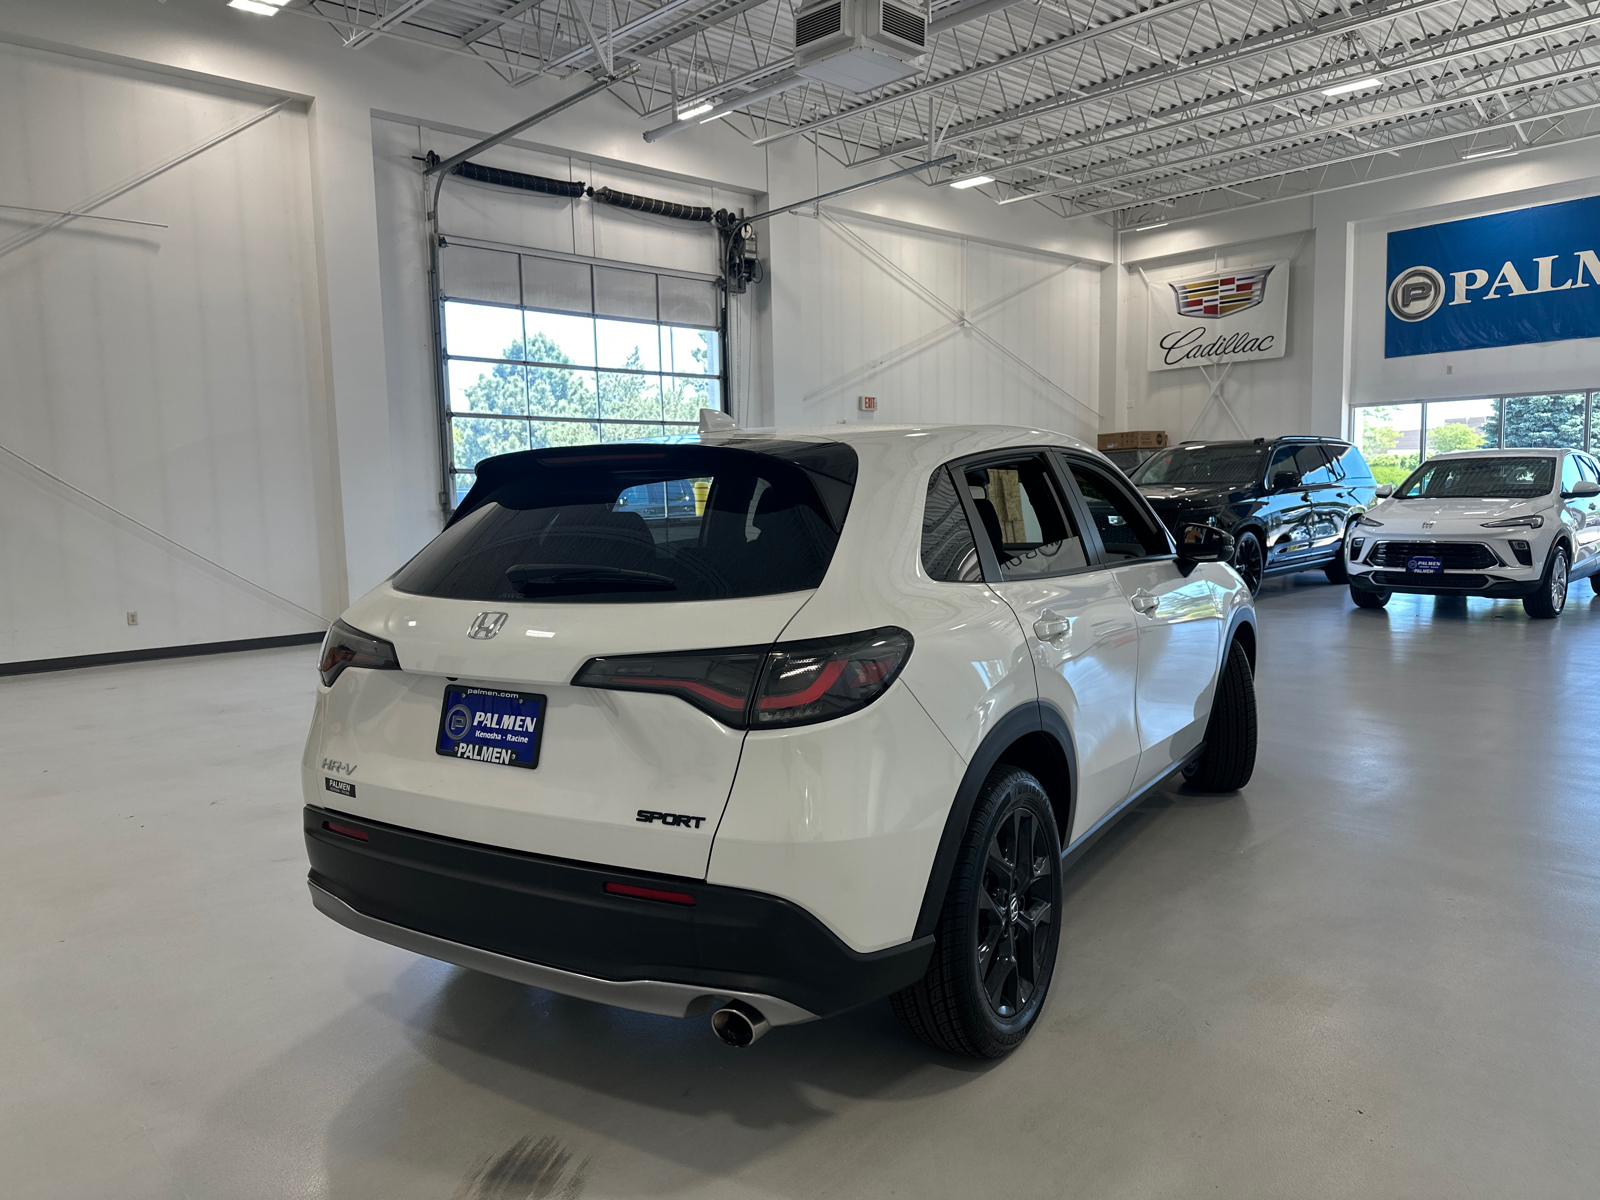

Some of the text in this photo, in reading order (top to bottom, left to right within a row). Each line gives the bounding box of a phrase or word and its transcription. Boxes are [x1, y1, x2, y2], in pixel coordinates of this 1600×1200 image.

[1160, 326, 1275, 365] Cadillac
[864, 396, 876, 409] EXIT
[467, 687, 519, 699] palmen.com
[472, 711, 537, 732] PALMEN
[475, 730, 502, 741] Kenosha
[506, 733, 529, 744] Racine
[457, 743, 511, 765] PALMEN
[321, 758, 357, 776] HR-V
[329, 779, 351, 792] PALMEN
[636, 809, 707, 829] SPORT
